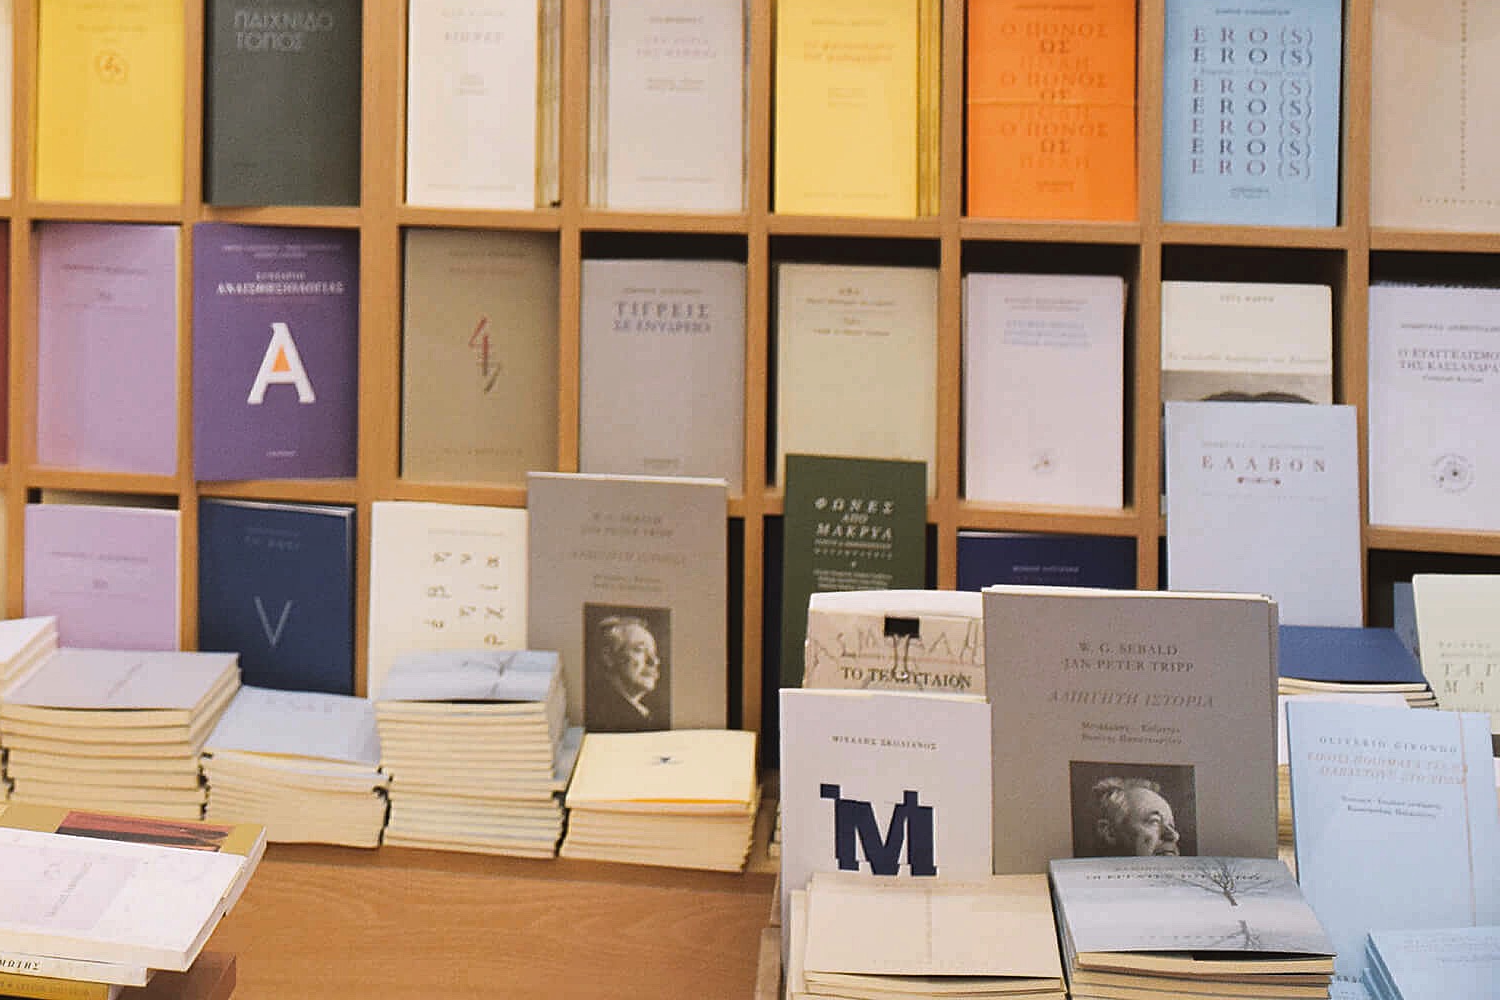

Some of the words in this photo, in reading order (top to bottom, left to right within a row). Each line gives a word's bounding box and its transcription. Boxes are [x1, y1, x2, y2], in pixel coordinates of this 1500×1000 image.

[1411, 348, 1500, 363] ΕΥΑΓΓΕΛΙΣΜΟ
[1425, 360, 1500, 375] ΚΑΣΣΑΝΔΡΑ
[1118, 642, 1179, 656] SEBALD
[1097, 658, 1145, 672] PETER
[1150, 661, 1195, 673] TRIPP
[840, 666, 863, 681] ΤΟ
